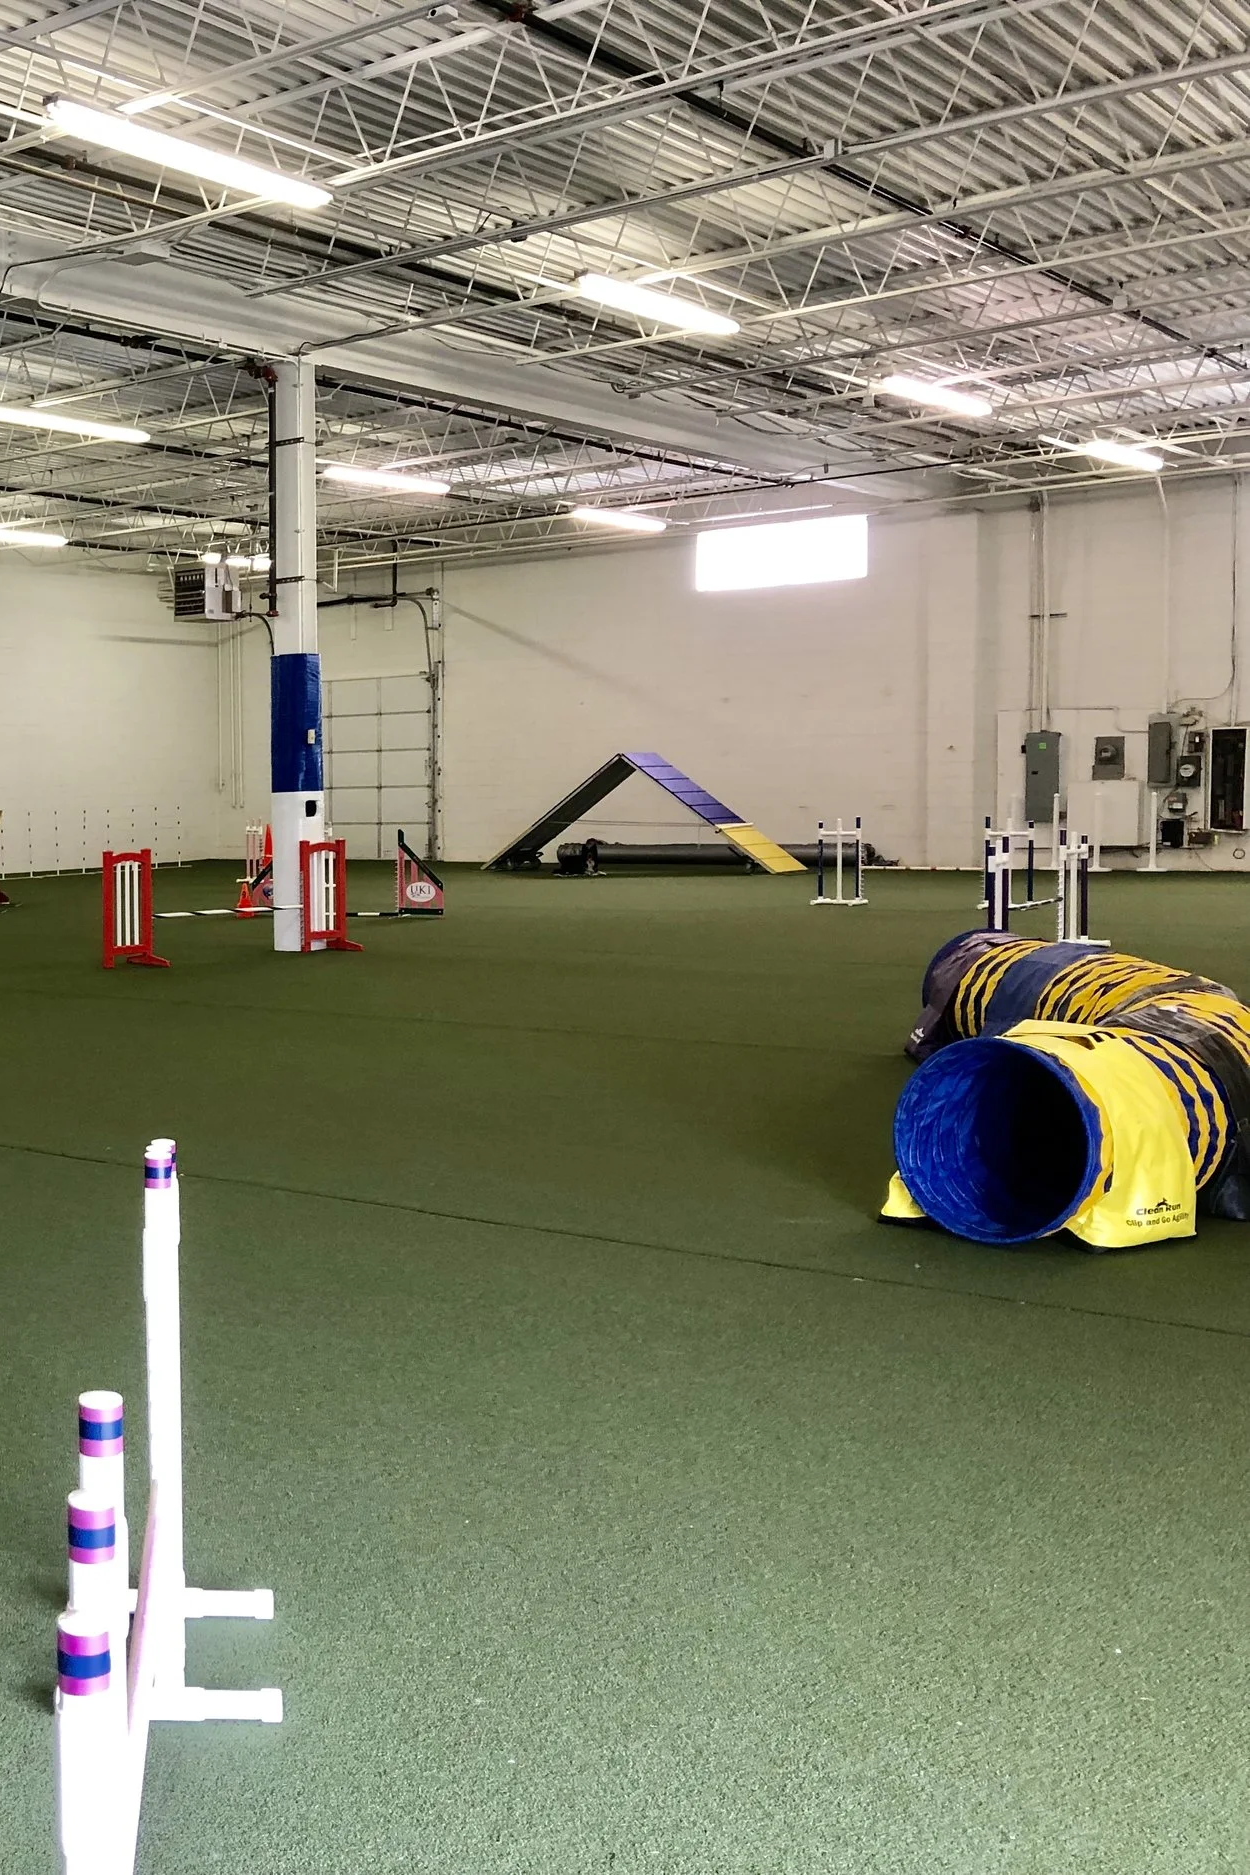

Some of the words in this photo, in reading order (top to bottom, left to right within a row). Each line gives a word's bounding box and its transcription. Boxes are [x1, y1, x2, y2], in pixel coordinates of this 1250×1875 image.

[411, 885, 430, 895] UKI
[1136, 1207, 1163, 1215] Clean
[1166, 1203, 1181, 1211] Run
[1126, 1219, 1142, 1227] Clip
[1146, 1218, 1160, 1226] and
